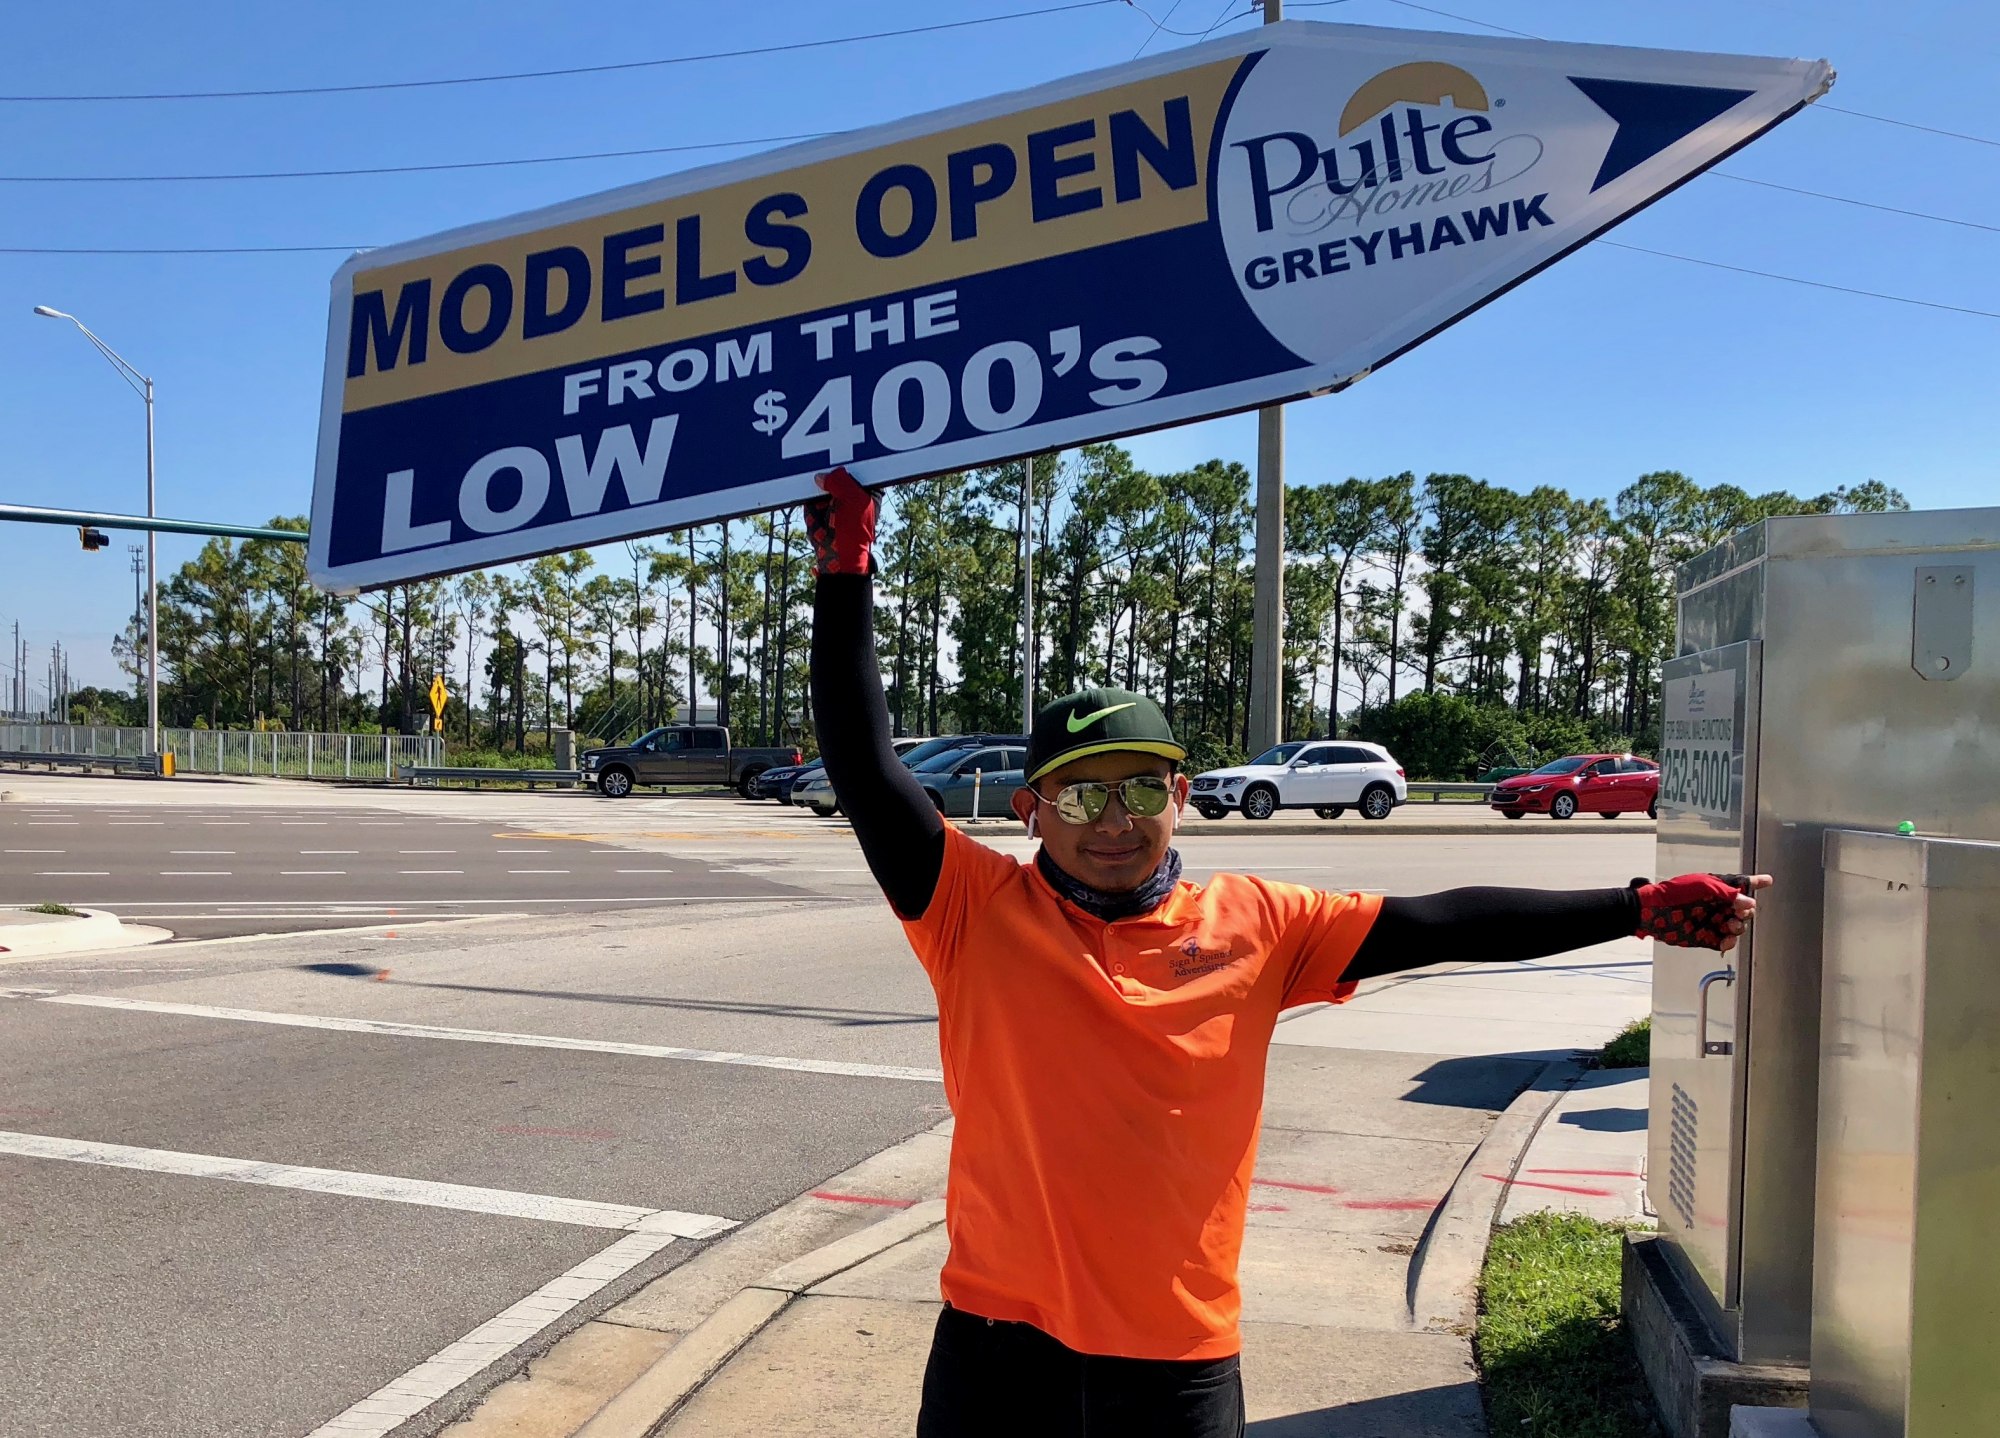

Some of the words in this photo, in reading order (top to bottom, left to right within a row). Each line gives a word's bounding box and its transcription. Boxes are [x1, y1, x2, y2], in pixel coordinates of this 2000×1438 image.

[1230, 107, 1496, 233] Pulte
[1287, 133, 1544, 237] Homes
[347, 192, 812, 378] MODELS
[855, 95, 1198, 259] OPEN
[1244, 192, 1556, 290] GREYHAWK
[562, 331, 773, 415] FROM
[800, 289, 960, 361] THE
[380, 413, 680, 555] LOW
[1664, 747, 1730, 812] 252-5000
[1168, 959, 1190, 970] Sign
